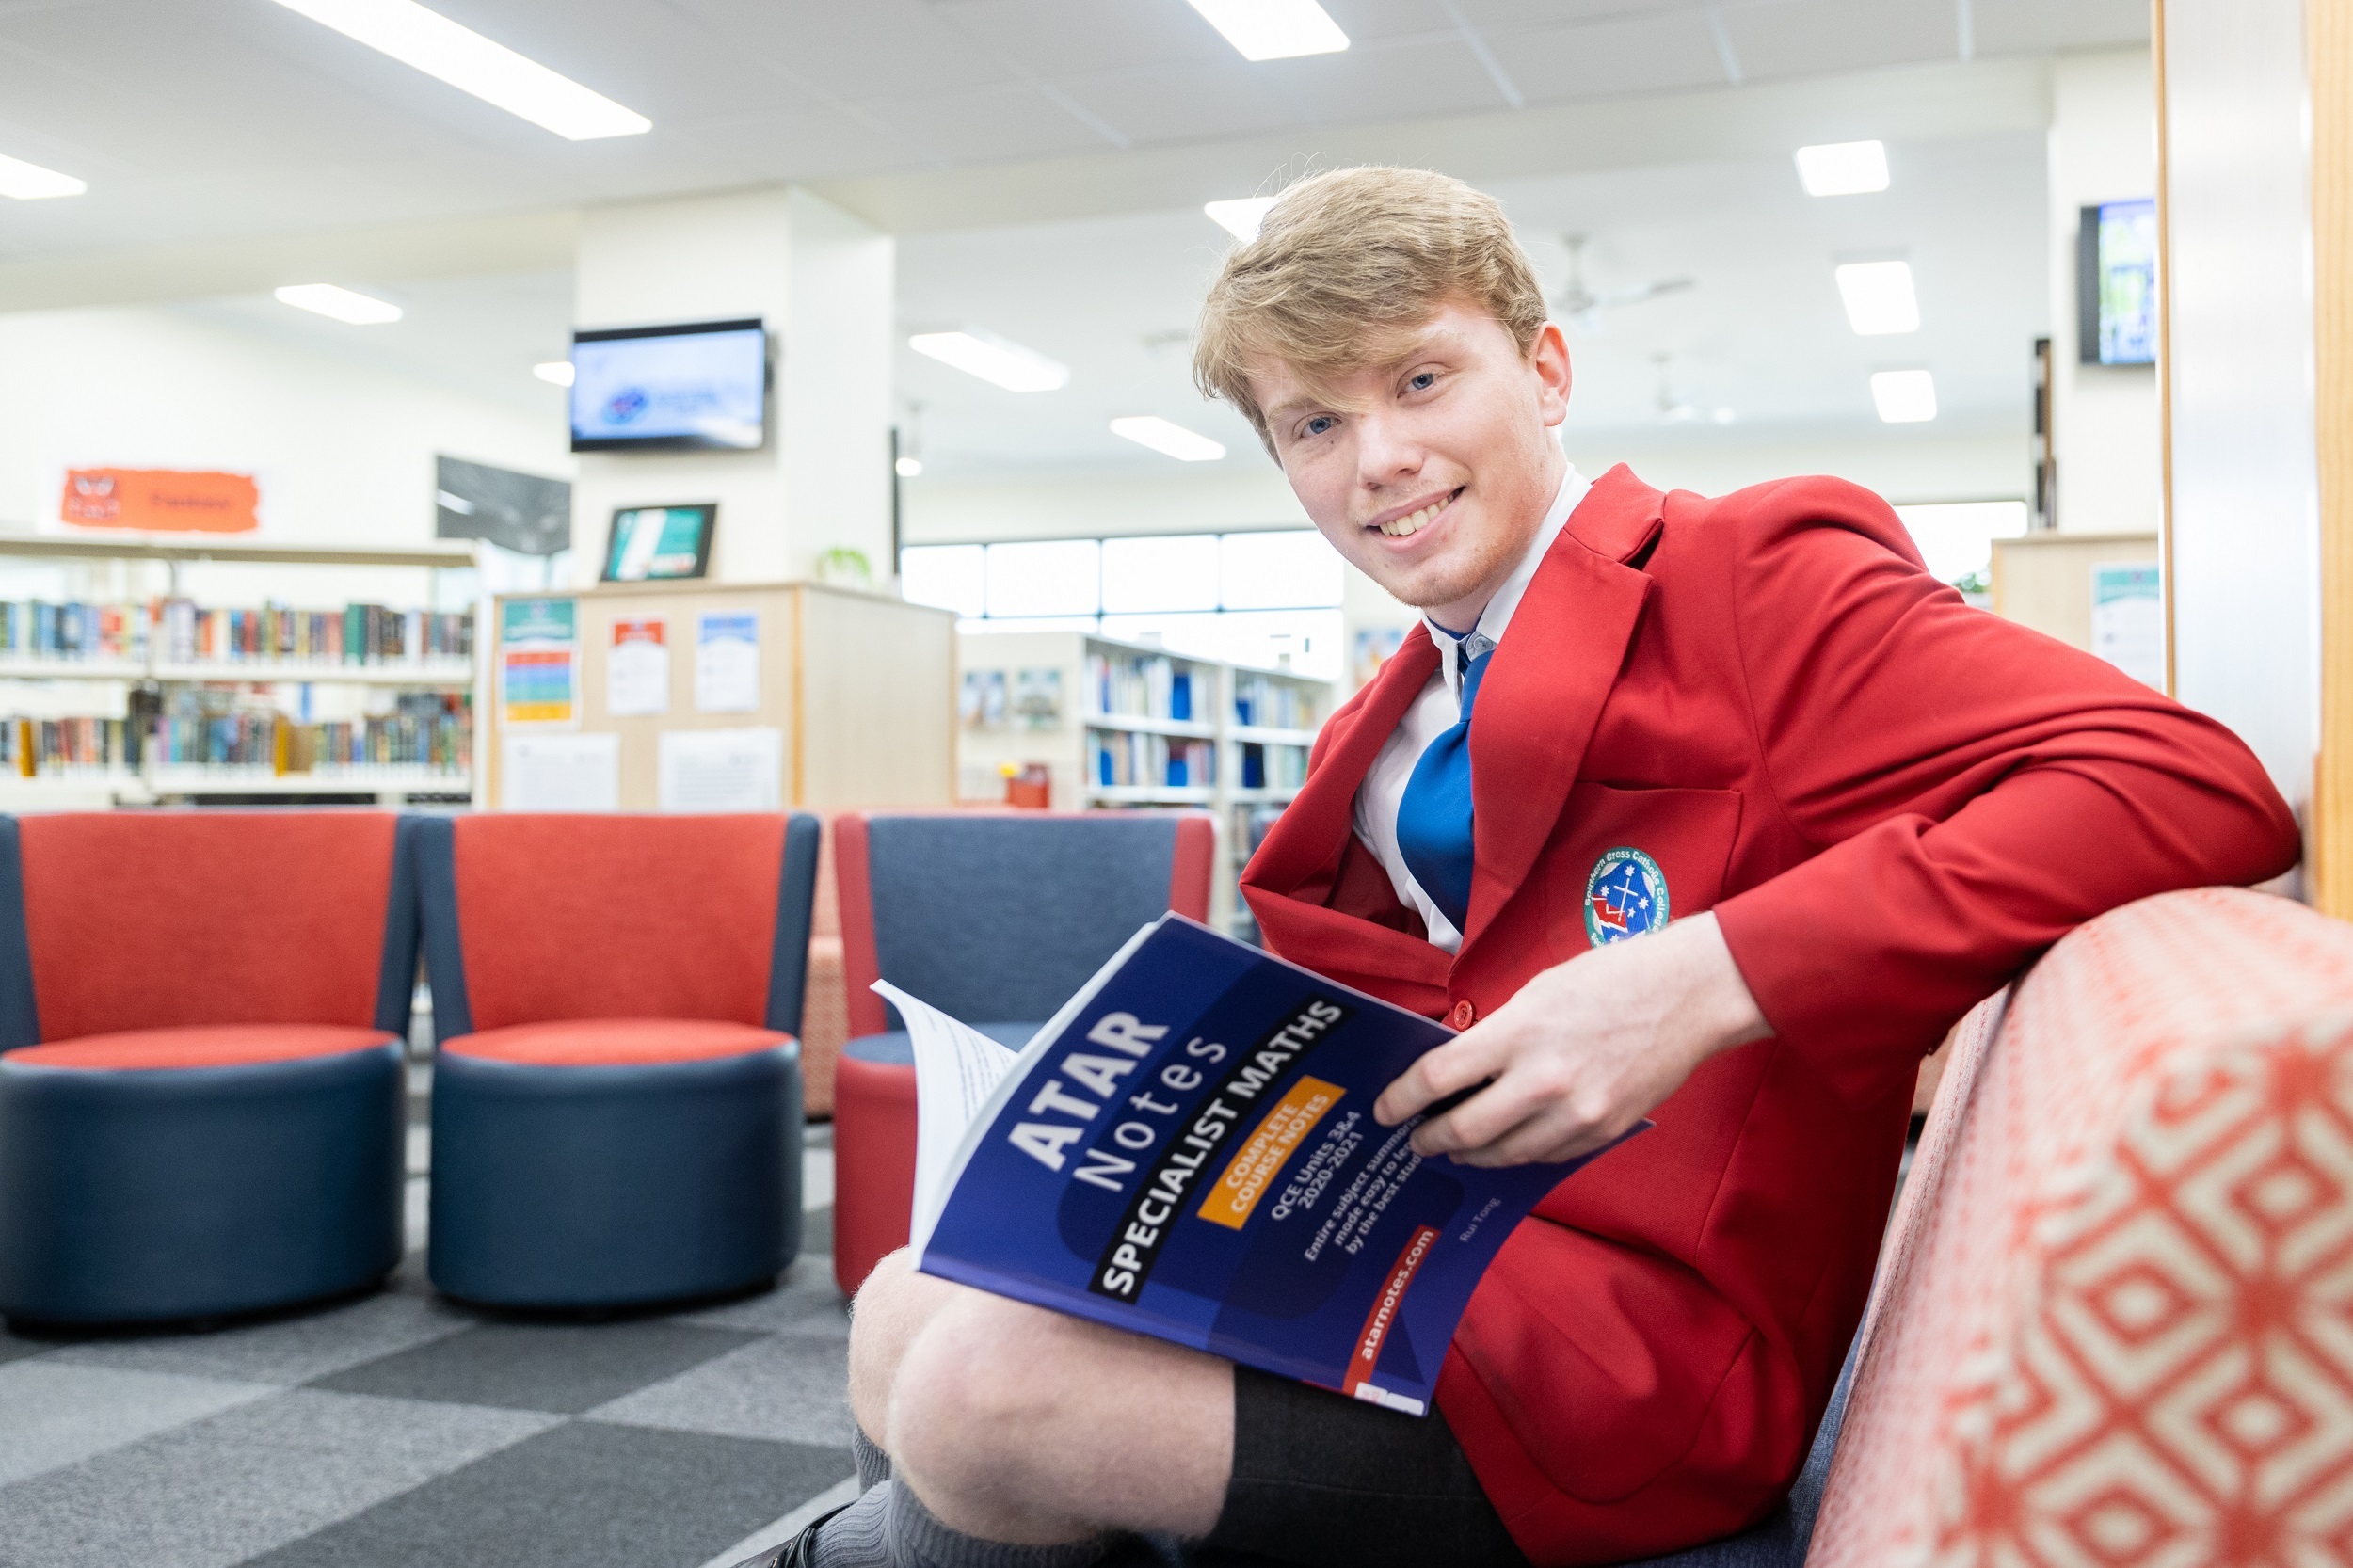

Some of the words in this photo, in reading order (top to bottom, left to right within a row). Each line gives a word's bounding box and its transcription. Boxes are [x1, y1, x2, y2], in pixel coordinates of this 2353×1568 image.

[1606, 850, 1631, 862] Cross
[1632, 851, 1660, 886] Catholic
[1007, 1011, 1170, 1172] ATAR
[1073, 1036, 1227, 1192] Notes
[1102, 1097, 1238, 1295] SPECIALIST
[1226, 1000, 1342, 1099] MATHS
[1225, 1103, 1299, 1189] COMPLETE
[1230, 1144, 1287, 1214] COURSE
[1277, 1094, 1330, 1145] NOTES
[1271, 1183, 1304, 1221] QCE
[1295, 1141, 1336, 1184] Units
[1327, 1111, 1362, 1142] 3&4
[1297, 1131, 1364, 1209] 2020-2021
[1334, 1206, 1364, 1247] made
[1360, 1175, 1387, 1208] easy
[1381, 1160, 1399, 1176] to
[1392, 1142, 1412, 1162] lea
[1304, 1218, 1337, 1262] Entire
[1332, 1171, 1370, 1220] subject
[1344, 1234, 1365, 1255] by
[1358, 1210, 1380, 1236] the
[1373, 1181, 1401, 1212] best
[1396, 1151, 1423, 1183] stud
[1460, 1224, 1479, 1243] Rui
[1473, 1197, 1502, 1223] Tong
[1361, 1229, 1434, 1361] atarnotes.com
